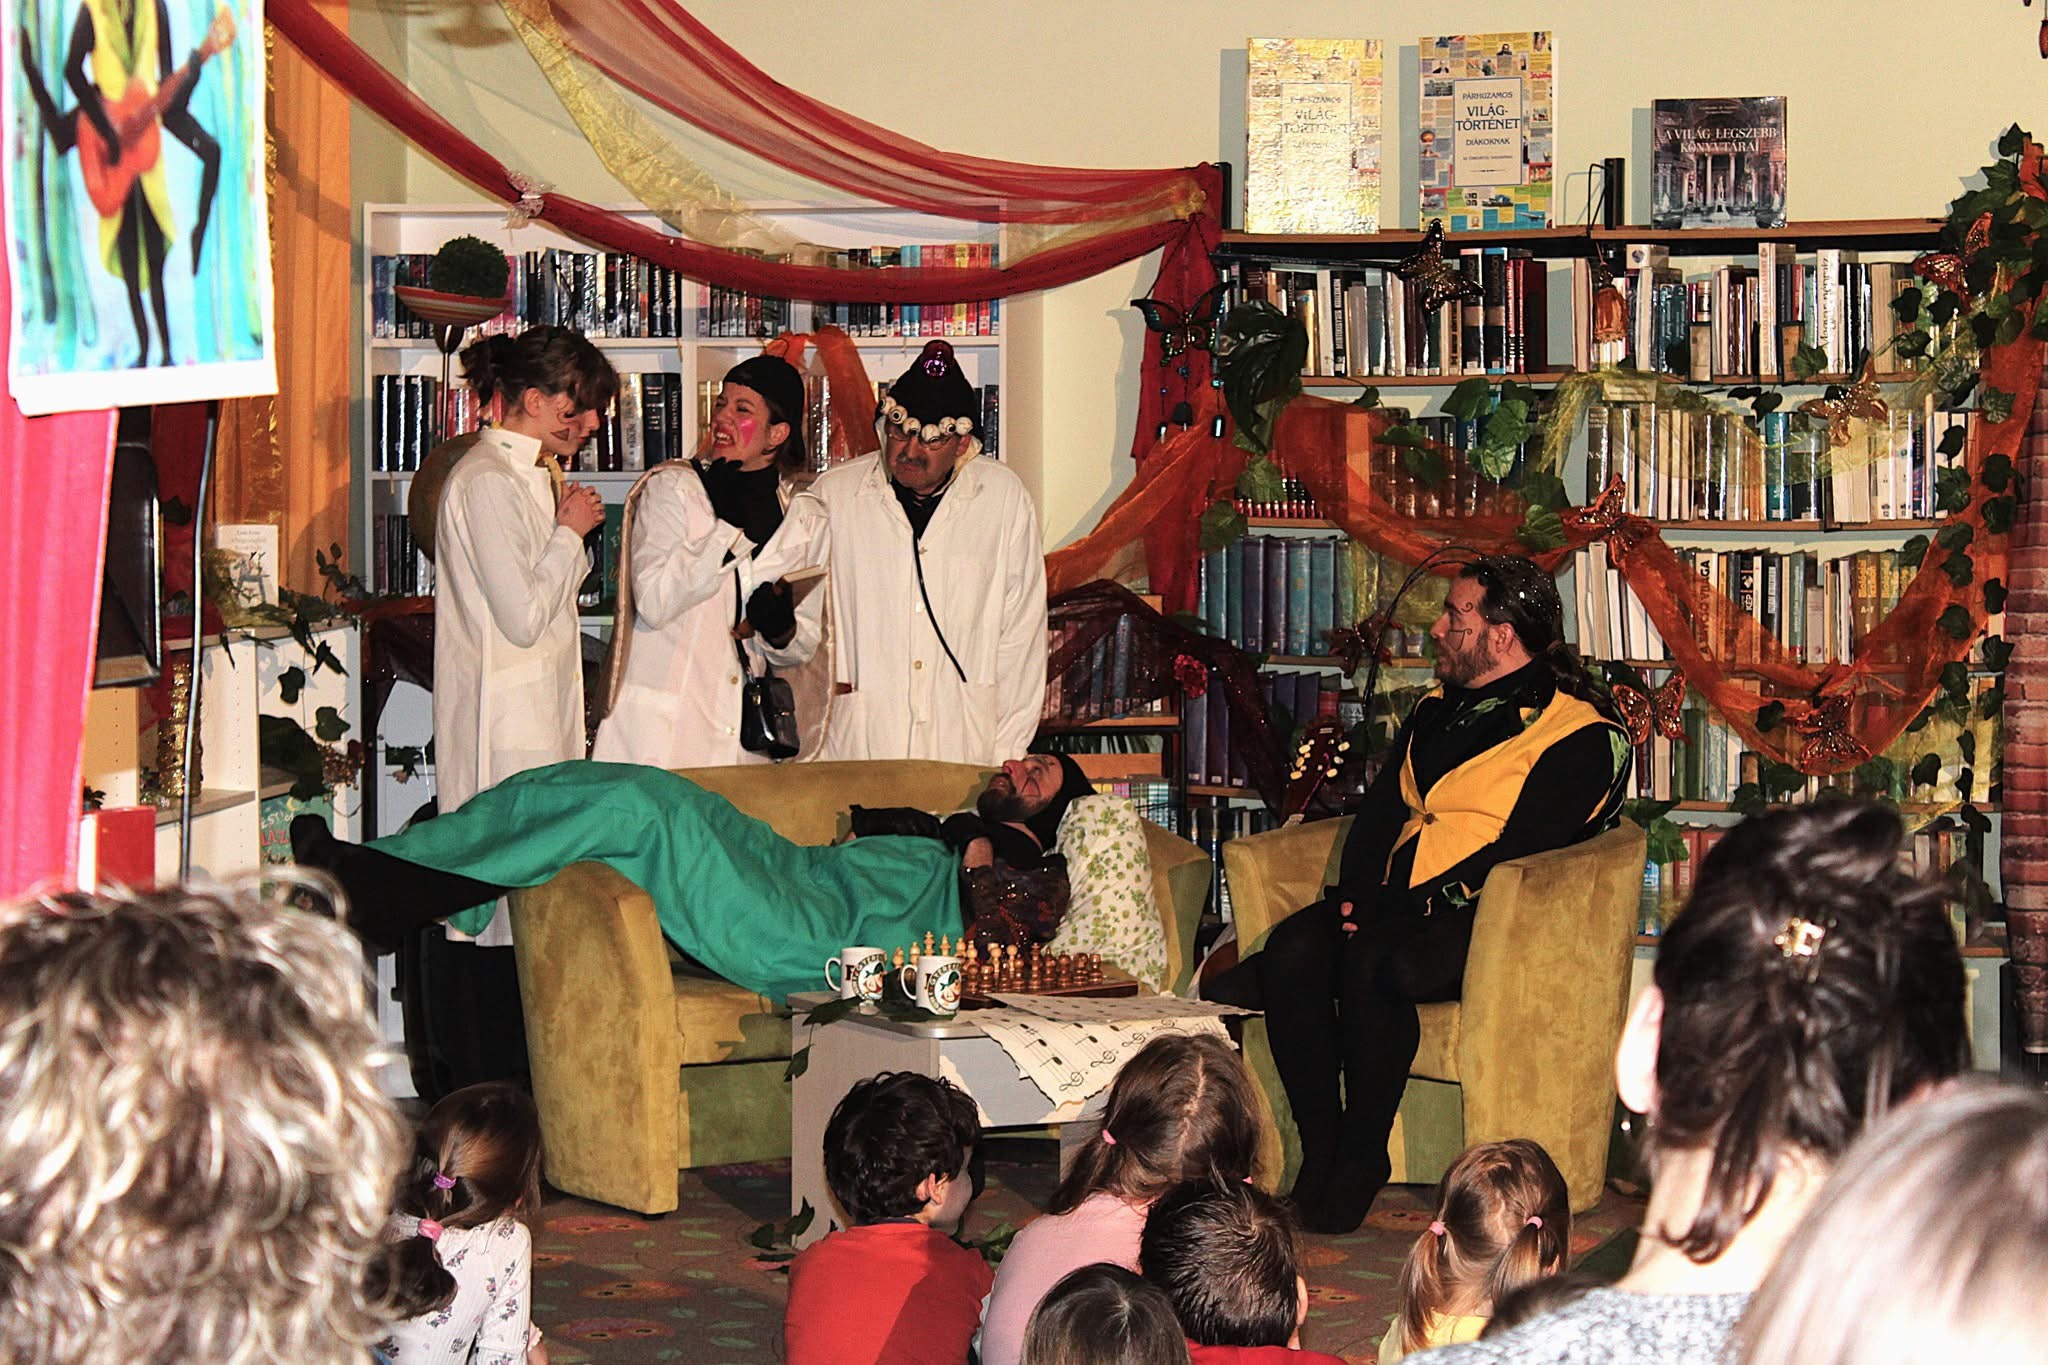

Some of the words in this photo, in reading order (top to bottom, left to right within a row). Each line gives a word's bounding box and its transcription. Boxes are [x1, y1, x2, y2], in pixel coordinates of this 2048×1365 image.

[1462, 91, 1513, 100] PÁRHUZAMOS
[1467, 103, 1508, 117] VILÁG-
[1456, 116, 1520, 132] TÖRTÉNET
[1664, 128, 1673, 140] A
[1674, 126, 1711, 140] VILÁG
[1716, 126, 1777, 139] LEGSZEBB
[1466, 137, 1511, 146] DIÁKOKNAK
[1680, 139, 1760, 153] KÖNYVTÁRAI
